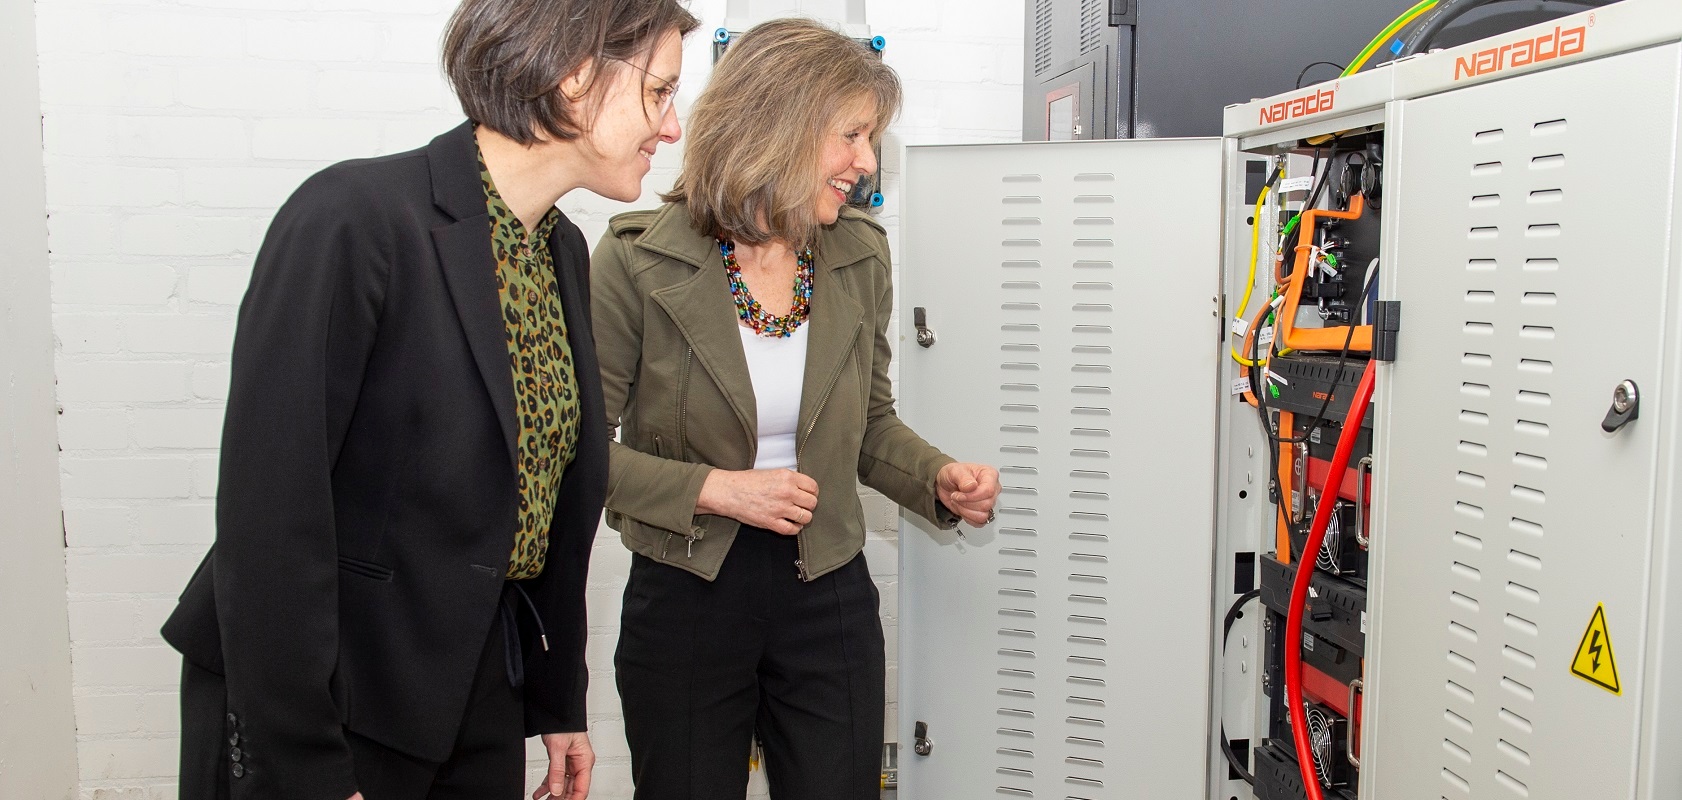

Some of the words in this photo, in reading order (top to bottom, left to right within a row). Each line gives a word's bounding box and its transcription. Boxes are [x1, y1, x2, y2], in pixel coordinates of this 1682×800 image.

[1454, 26, 1586, 80] Narada
[1259, 89, 1335, 125] Narada
[1312, 391, 1335, 401] Naraa
